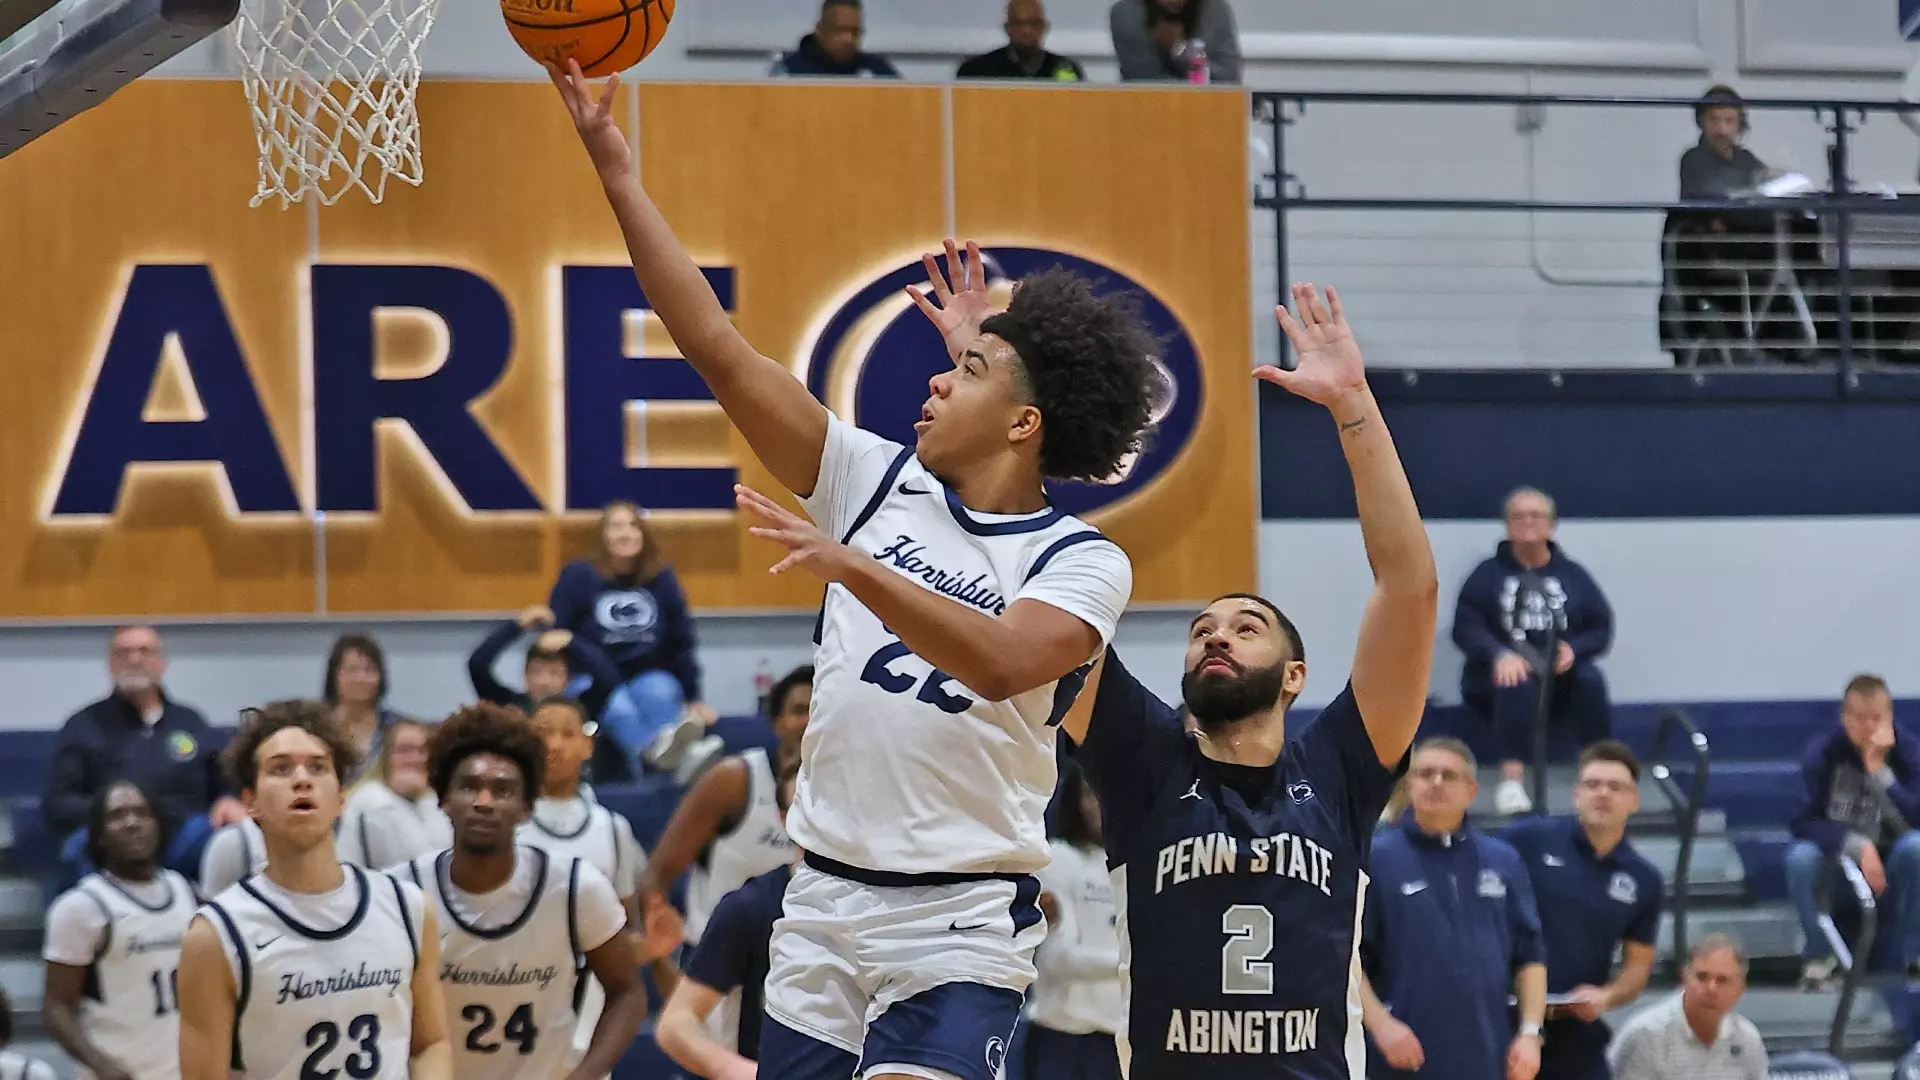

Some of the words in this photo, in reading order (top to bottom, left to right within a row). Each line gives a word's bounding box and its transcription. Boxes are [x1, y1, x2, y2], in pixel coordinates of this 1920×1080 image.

[51, 264, 739, 512] ARE
[873, 535, 1007, 616] Harrisbur
[1154, 832, 1238, 896] PENN
[1250, 832, 1334, 897] STATE
[440, 963, 559, 992] Harrisburg
[1222, 904, 1274, 995] 2
[276, 961, 402, 1005] Harrisburg
[300, 1013, 381, 1080] 23
[461, 1003, 538, 1055] 24
[1166, 1008, 1320, 1054] ABINGTON
